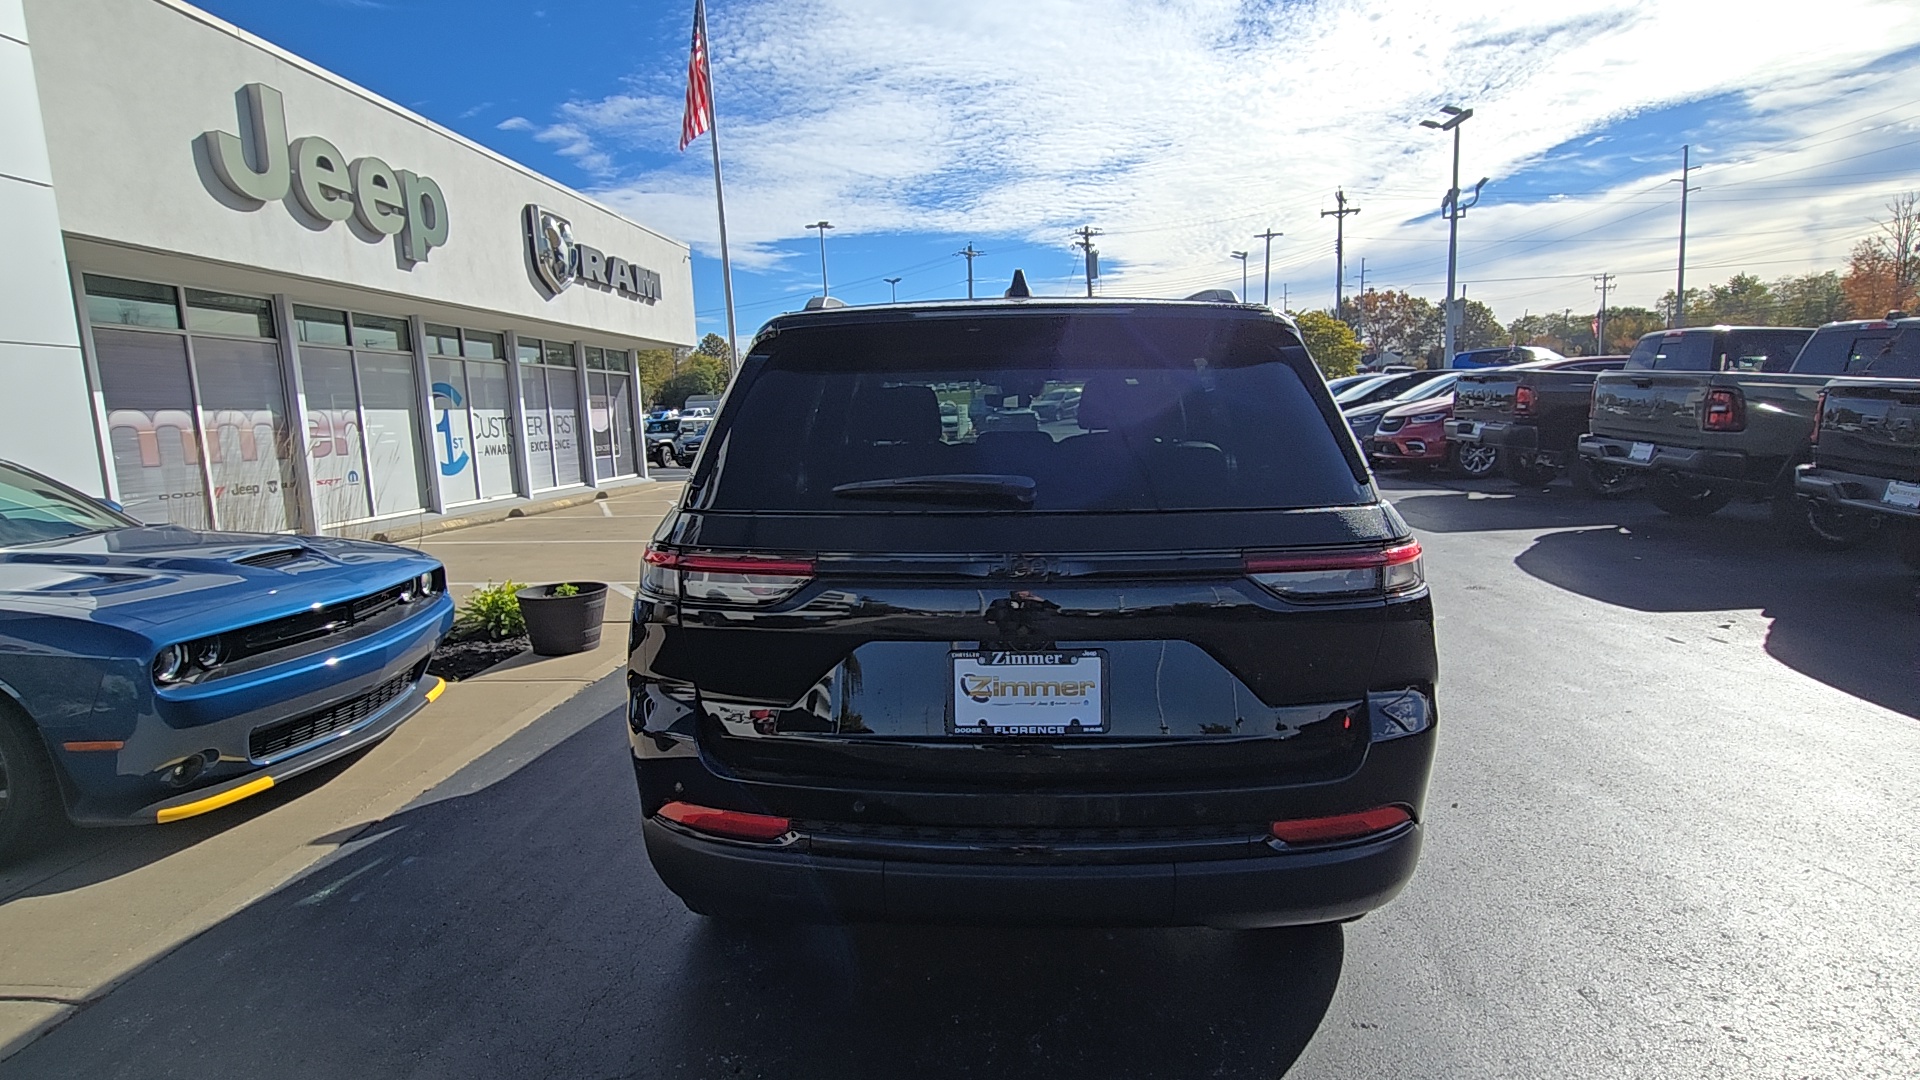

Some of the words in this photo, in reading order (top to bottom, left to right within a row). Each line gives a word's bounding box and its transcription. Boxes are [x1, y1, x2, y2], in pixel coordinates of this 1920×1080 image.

[192, 83, 449, 270] Jeep
[577, 244, 662, 304] RAM
[473, 412, 543, 439] CUSTOER
[549, 414, 576, 434] IRST
[484, 443, 513, 457] AWARD
[231, 483, 260, 496] Jeep
[316, 477, 343, 487] SRT
[991, 651, 1063, 665] Zimmer
[968, 675, 1096, 698] Zimmer
[993, 726, 1065, 734] FLORENCE
